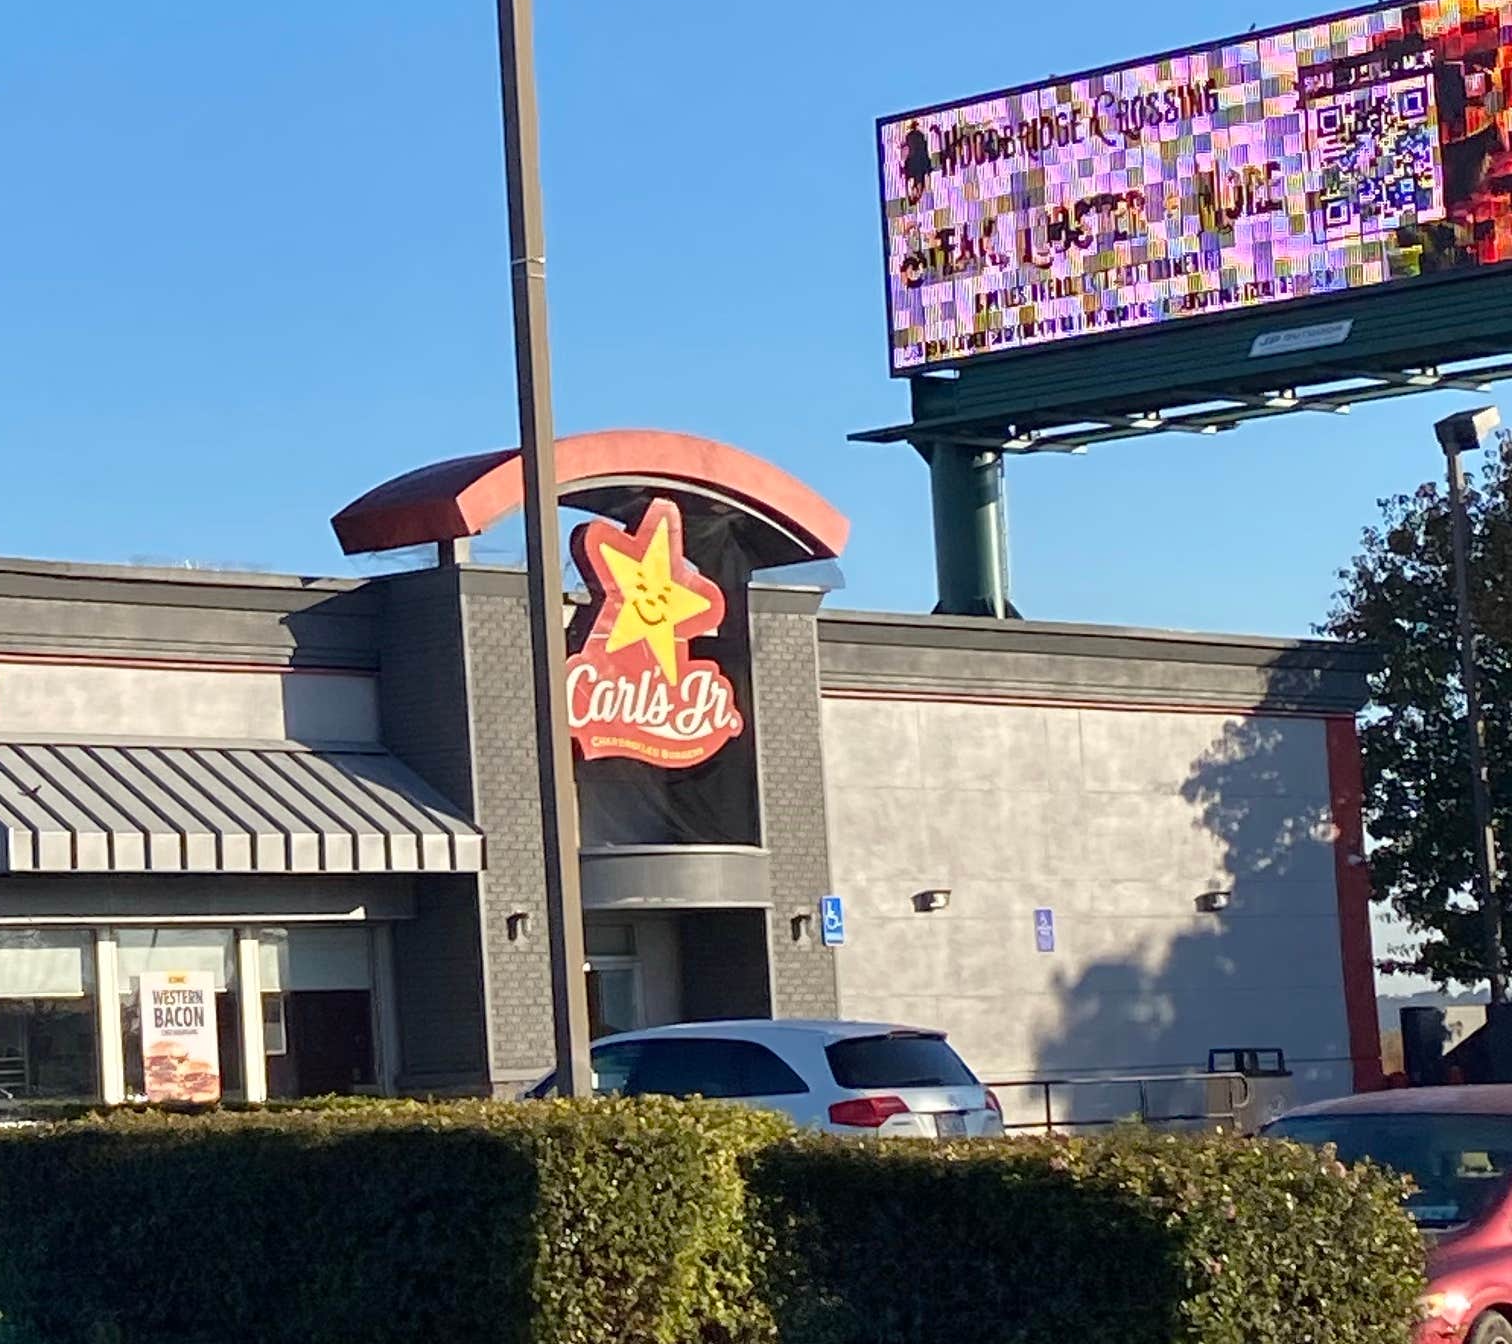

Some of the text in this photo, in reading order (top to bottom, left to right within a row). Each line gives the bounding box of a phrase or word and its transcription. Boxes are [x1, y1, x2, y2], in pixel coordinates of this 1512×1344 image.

[930, 79, 1219, 177] WOODBRIDGE CROSSING
[566, 664, 738, 736] Carl's Jr.
[152, 989, 203, 1006] WESTERN
[153, 1006, 204, 1028] BACON
